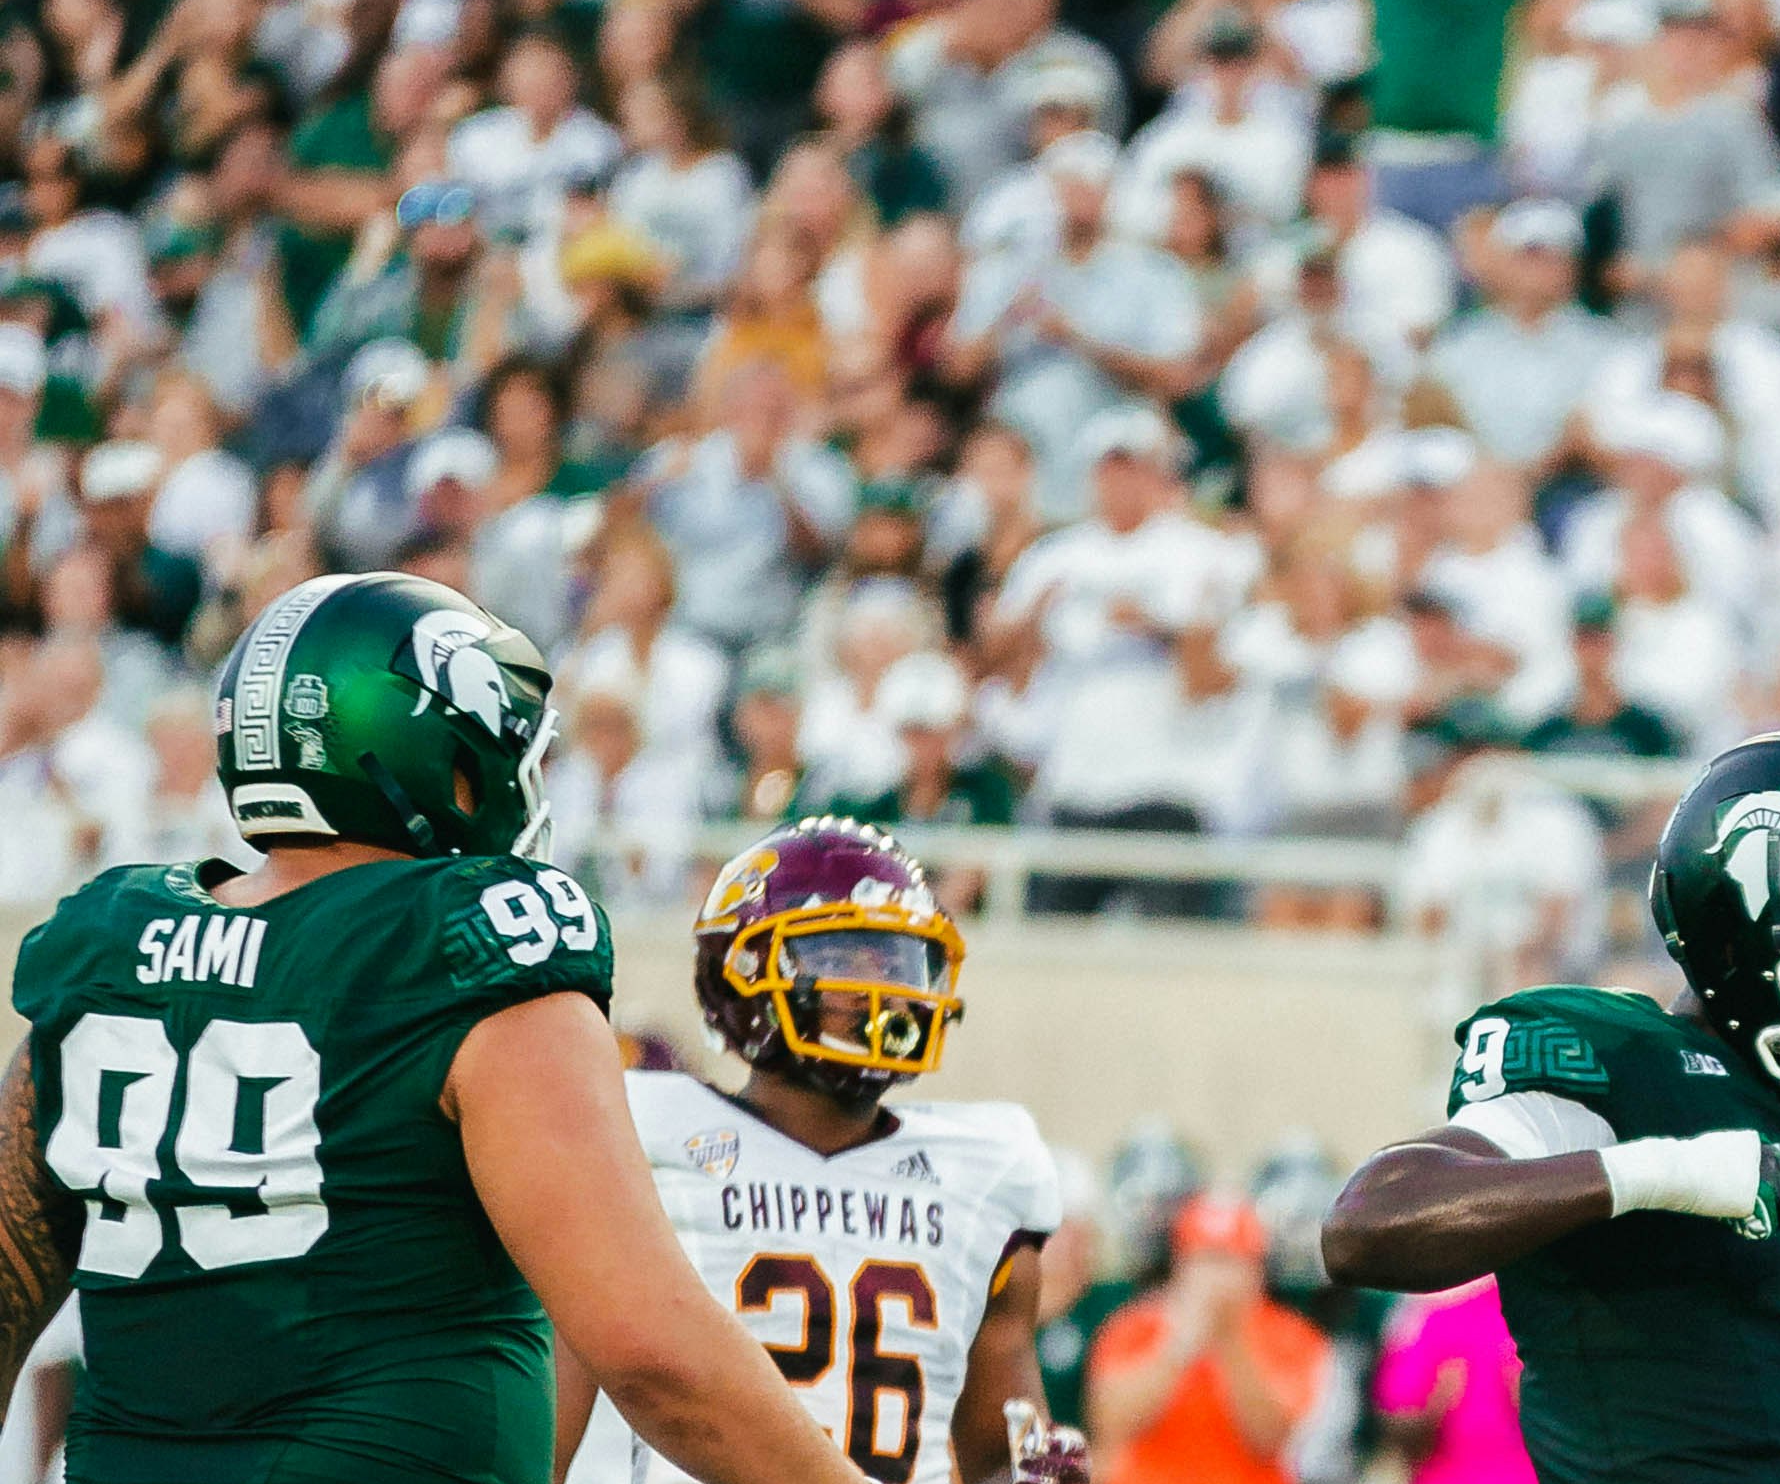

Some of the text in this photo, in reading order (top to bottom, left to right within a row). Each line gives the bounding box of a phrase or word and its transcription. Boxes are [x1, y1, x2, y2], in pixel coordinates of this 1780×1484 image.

[136, 915, 268, 988] SAMI
[480, 869, 598, 967] 99
[1460, 1016, 1511, 1102] 9
[45, 1012, 329, 1279] 99
[721, 1180, 944, 1247] CHIPPEWAS
